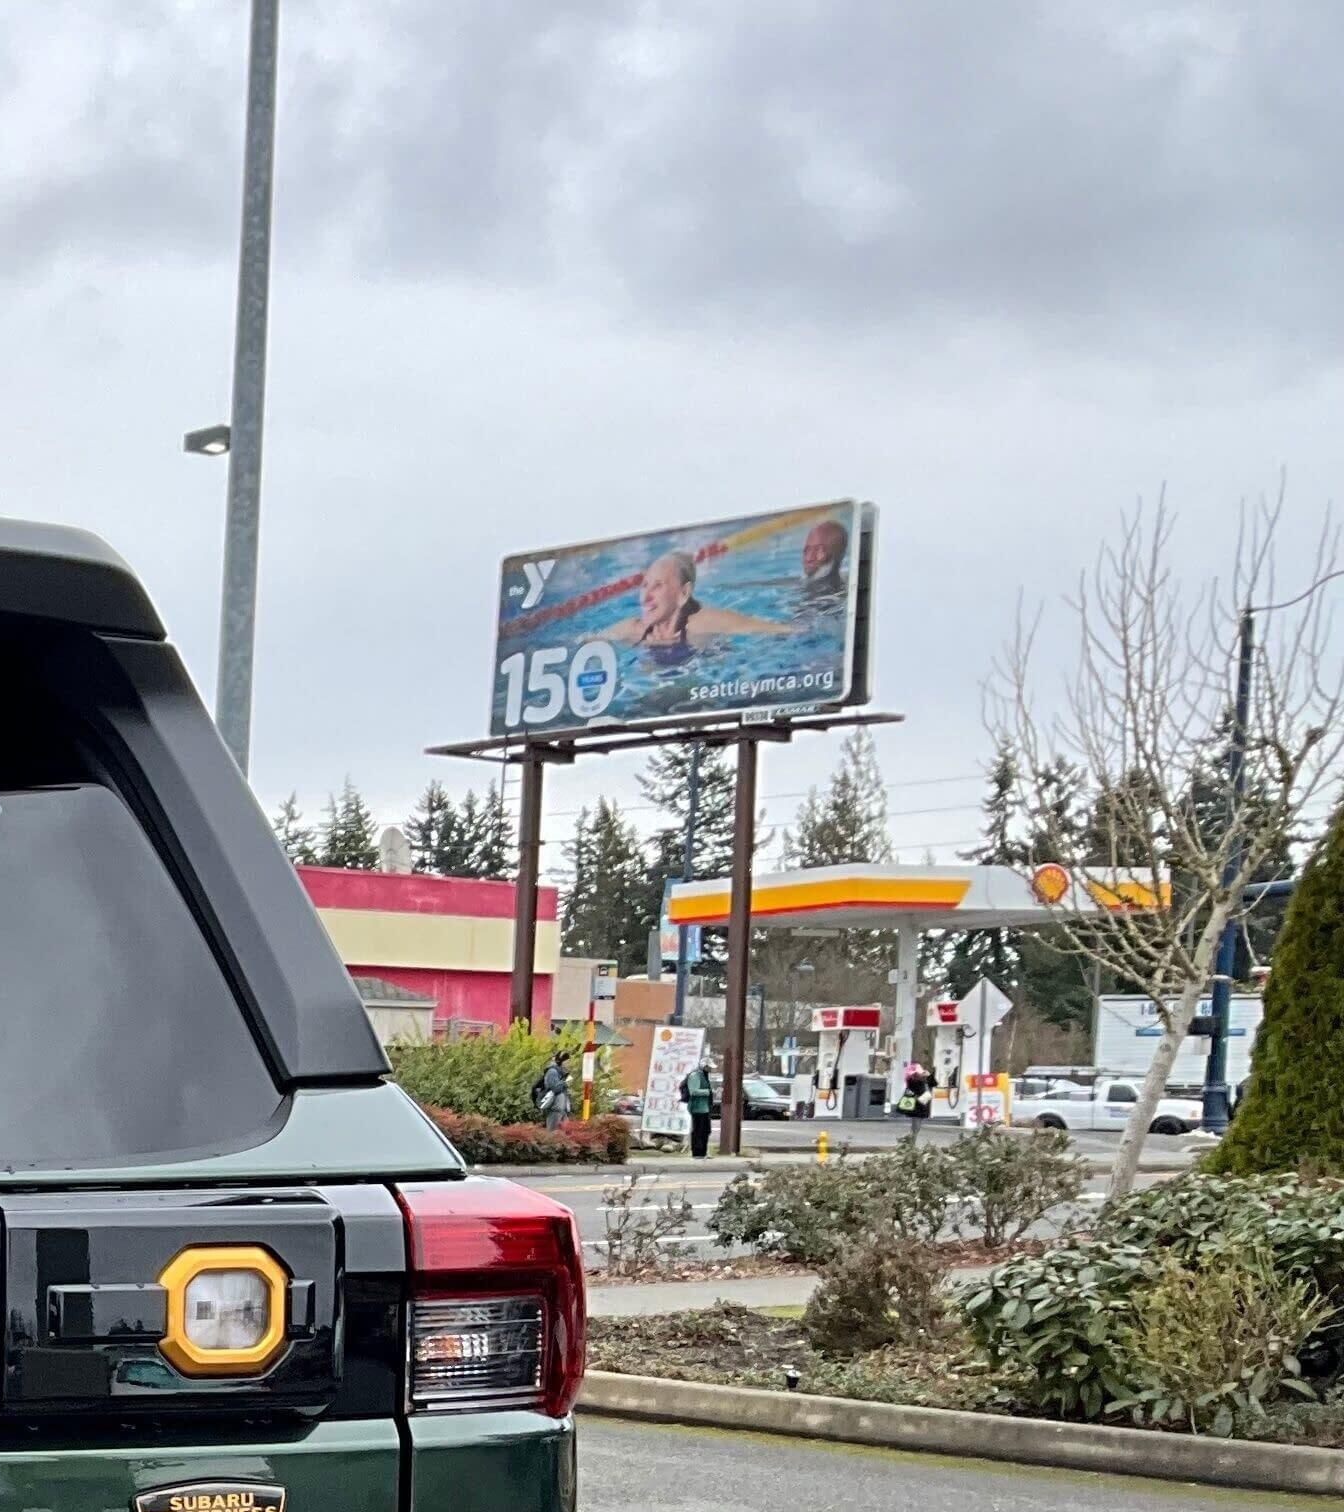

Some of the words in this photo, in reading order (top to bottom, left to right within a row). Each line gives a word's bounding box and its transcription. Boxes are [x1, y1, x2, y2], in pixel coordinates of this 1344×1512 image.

[500, 640, 617, 727] 150
[689, 671, 834, 700] seattleymca.org
[169, 1492, 254, 1511] SUBARU
